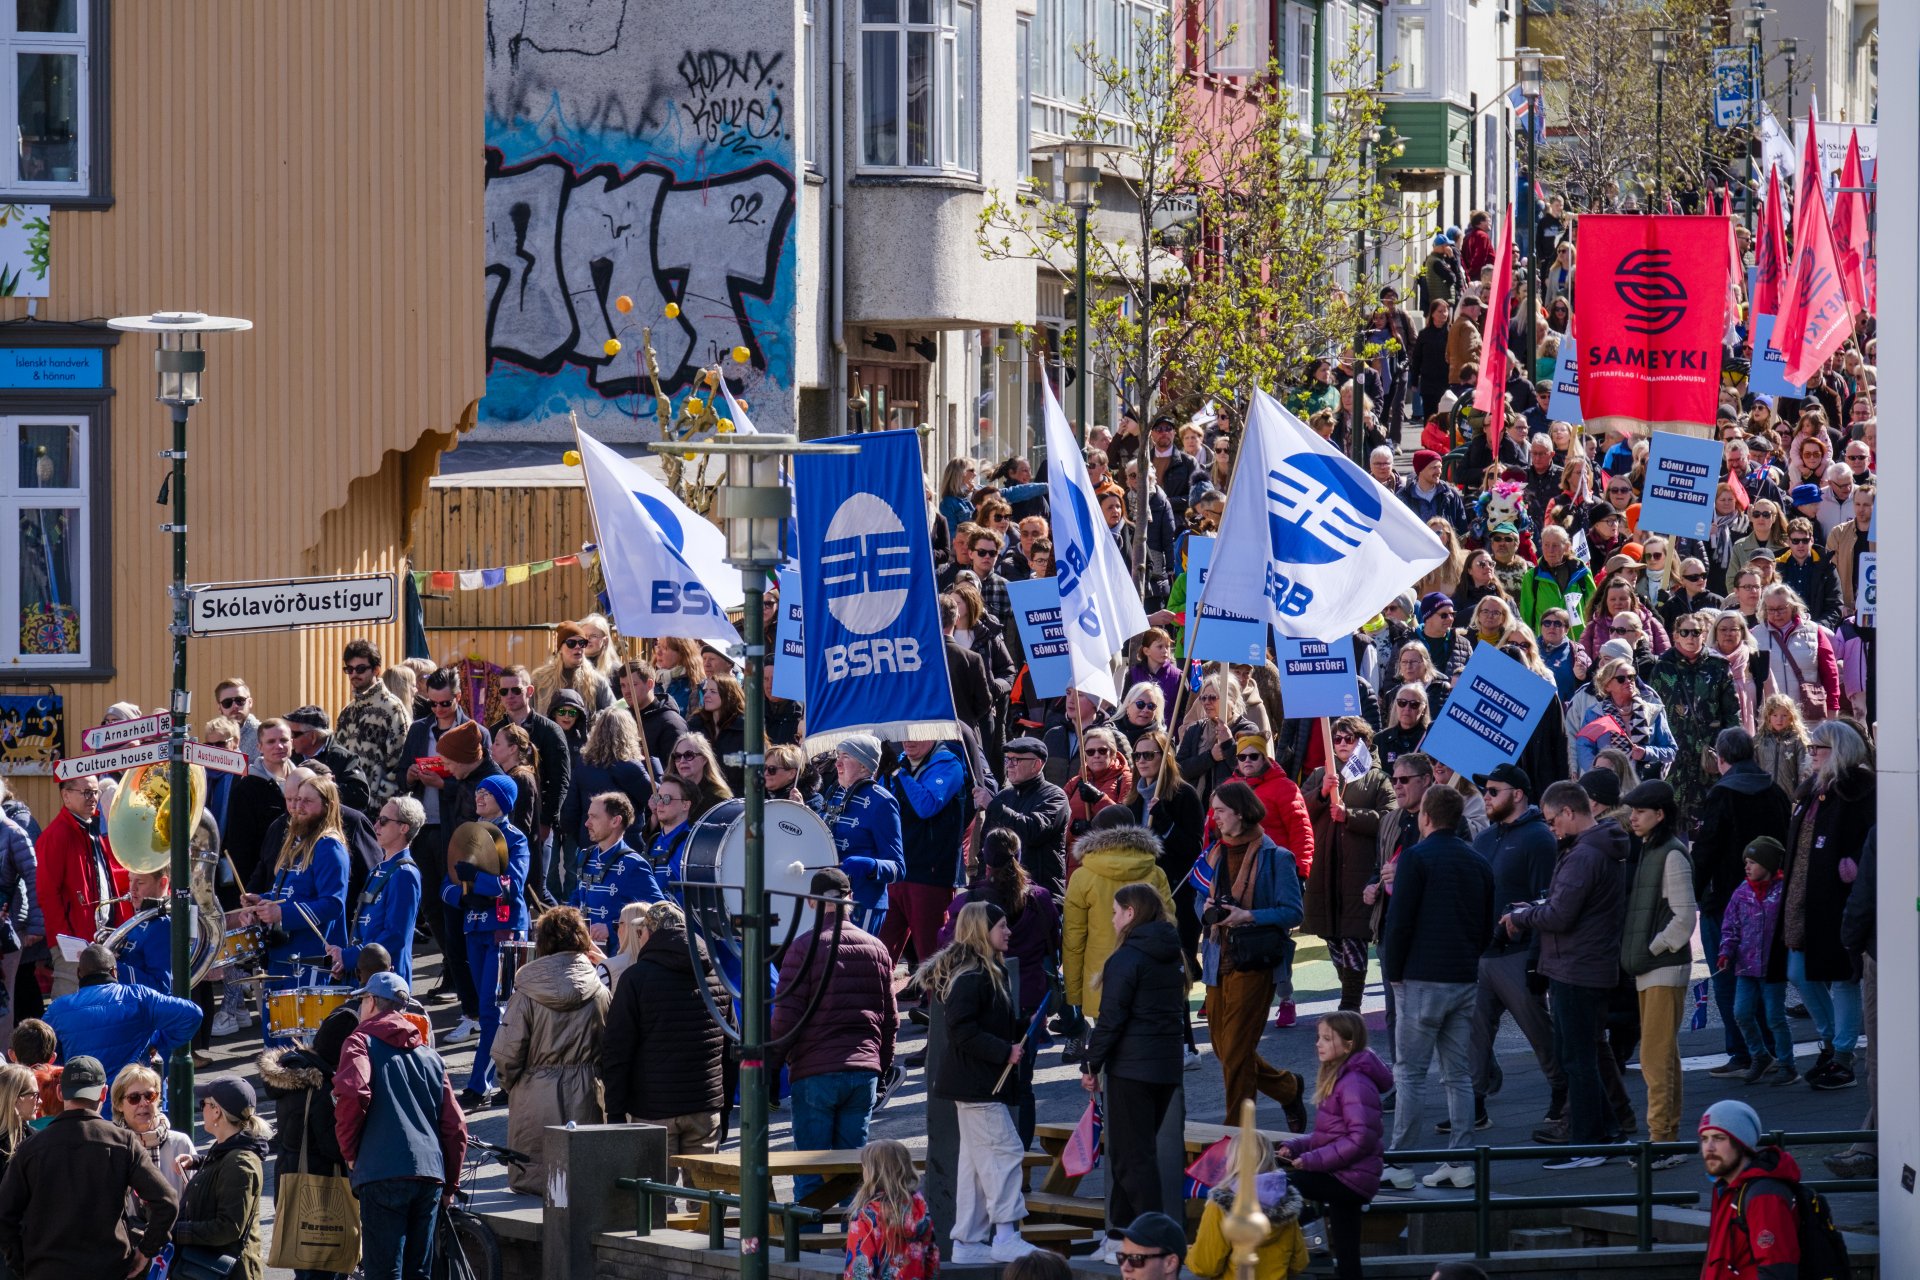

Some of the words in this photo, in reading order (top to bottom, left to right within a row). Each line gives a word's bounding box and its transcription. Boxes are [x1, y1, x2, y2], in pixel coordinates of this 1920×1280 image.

[49, 356, 89, 368] handverk
[1589, 346, 1707, 370] SAMEYKI
[33, 371, 40, 380] &
[43, 370, 76, 380] hönnun
[1661, 460, 1684, 471] SÖMU
[1686, 465, 1707, 475] LAUN
[1670, 476, 1693, 487] FYRIR
[1653, 487, 1676, 498] SÖMU
[1678, 491, 1706, 503] STÖRF!
[202, 589, 384, 619] Skólavörðustígur
[1028, 611, 1052, 623] SÖMU
[1044, 627, 1065, 637] FYRI
[785, 642, 803, 655] SÖM
[1033, 645, 1057, 656] SÖMU
[1302, 644, 1327, 654] FYRIR
[824, 637, 922, 683] BSRB
[1288, 661, 1313, 672] SÖMU
[1315, 660, 1345, 671] STÖRF!
[1472, 679, 1527, 718] LEIÐRÉTTUM
[1479, 703, 1504, 724] LAUN
[104, 724, 154, 742] Arnarhóll
[1449, 705, 1516, 753] KVENNASTÉTTA
[76, 758, 118, 773] Culture
[120, 752, 153, 767] house
[197, 749, 234, 767] Austurvöllur
